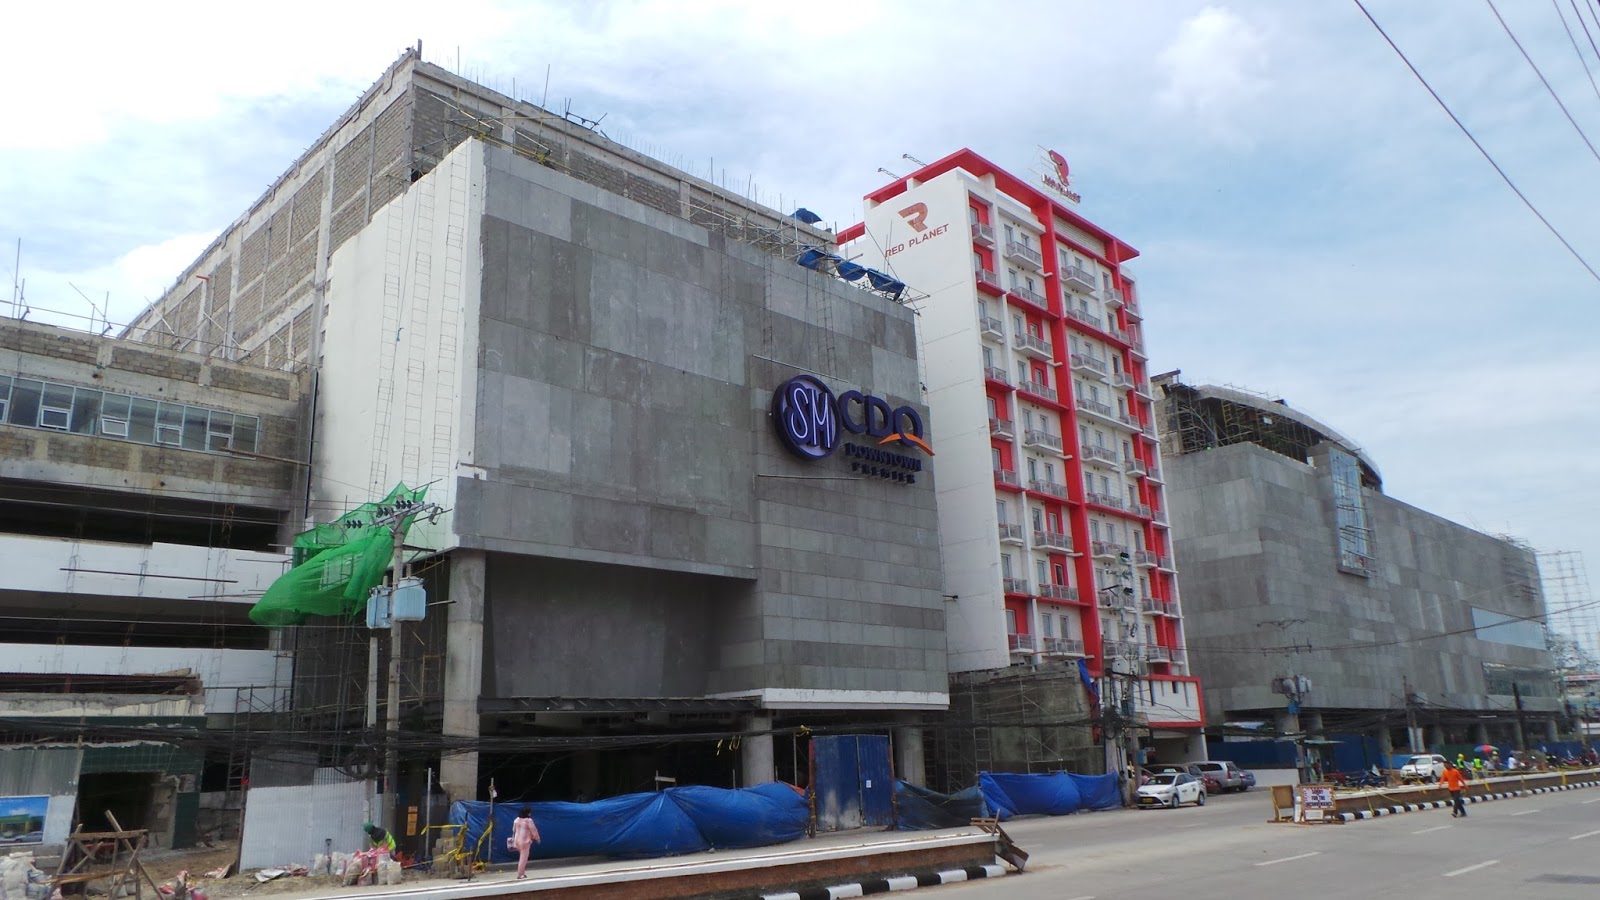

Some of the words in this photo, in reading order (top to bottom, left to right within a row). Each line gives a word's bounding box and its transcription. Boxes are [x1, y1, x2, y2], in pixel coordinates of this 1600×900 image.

[885, 243, 905, 258] RED
[908, 223, 949, 248] PLANET
[784, 382, 834, 450] SM
[844, 442, 922, 472] DOWNTOWN
